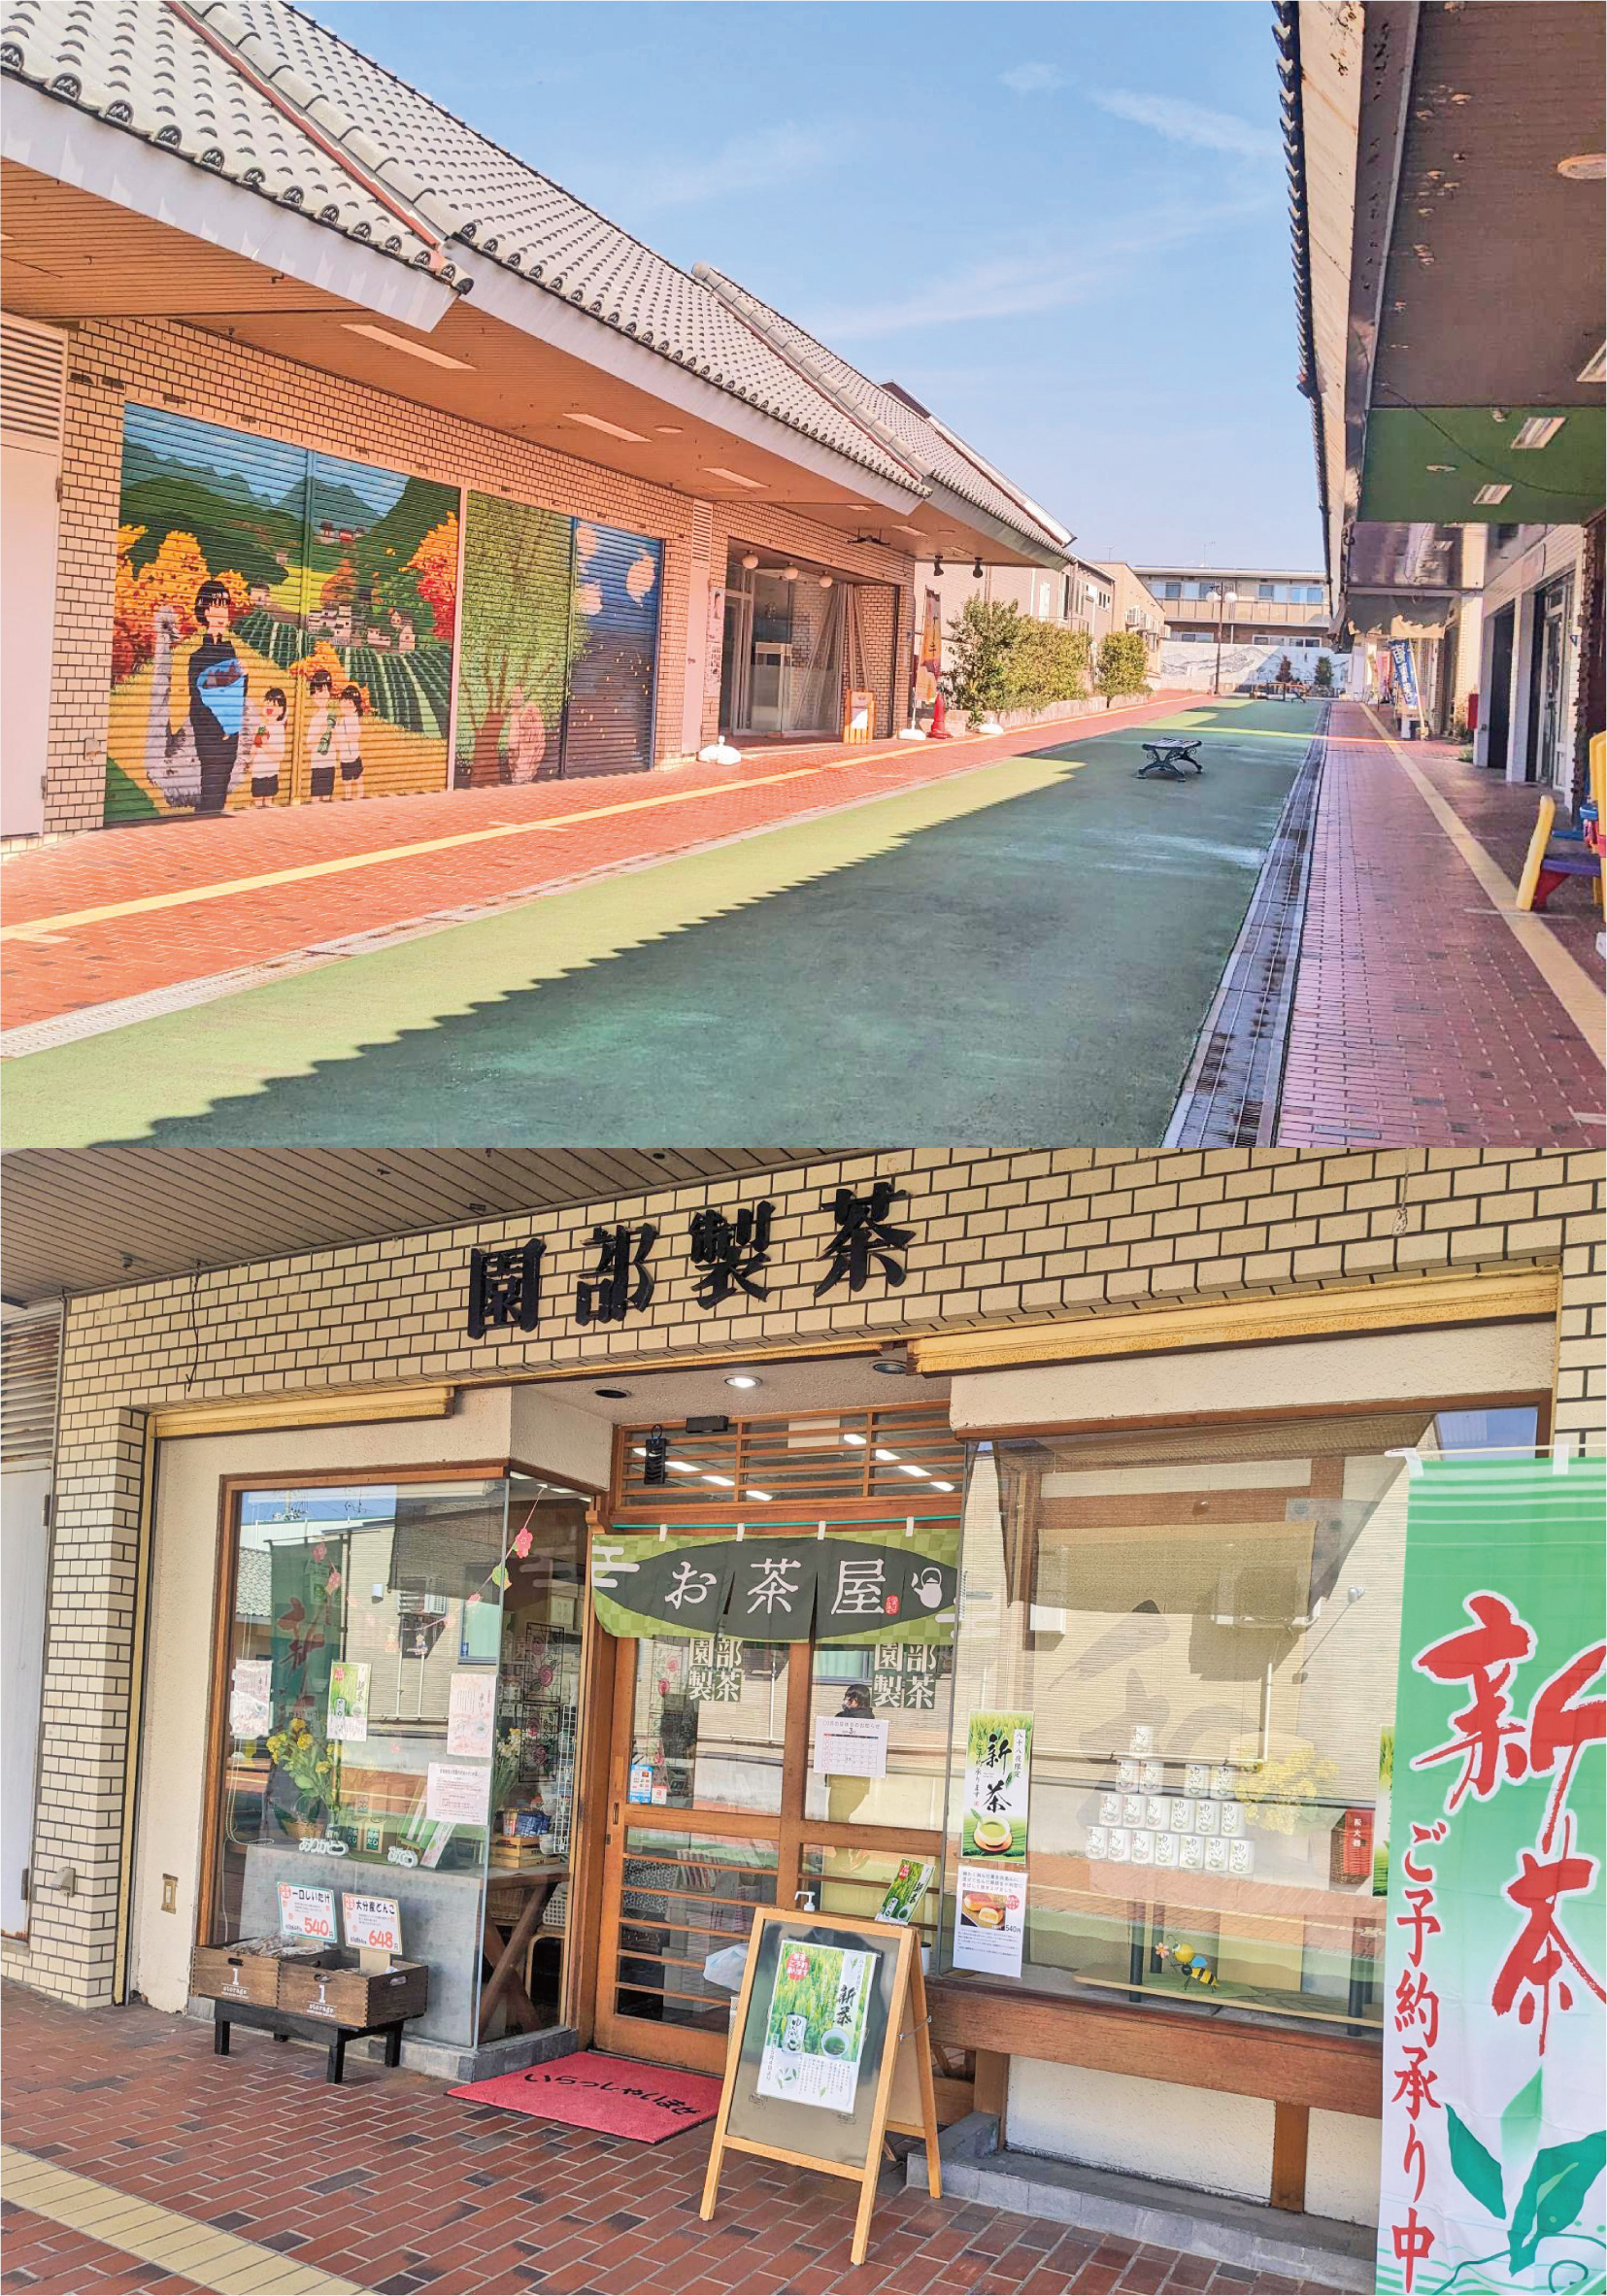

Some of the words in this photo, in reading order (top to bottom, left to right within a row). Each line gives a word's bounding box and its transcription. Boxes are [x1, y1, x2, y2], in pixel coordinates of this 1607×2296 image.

[664, 1558, 887, 1616] お茶屋
[688, 1638, 742, 1669] 園部
[875, 1643, 937, 1672] 園部
[687, 1671, 741, 1702] 製茶
[873, 1673, 935, 1709] 製茶
[1014, 1732, 1023, 1778] 八十八夜限定
[981, 1733, 1013, 1814] 新茶
[1416, 1594, 1606, 2057] 新茶
[291, 1889, 330, 1904] 一口しいたけ
[222, 1985, 248, 1995] storage
[233, 1967, 240, 1986] 1
[309, 2003, 334, 2014] storage
[318, 1984, 326, 2004] 1
[833, 1984, 857, 2026] 新茶
[1391, 1820, 1448, 2294] ご予約承り中
[523, 2073, 701, 2116] いらっしゃいませ
